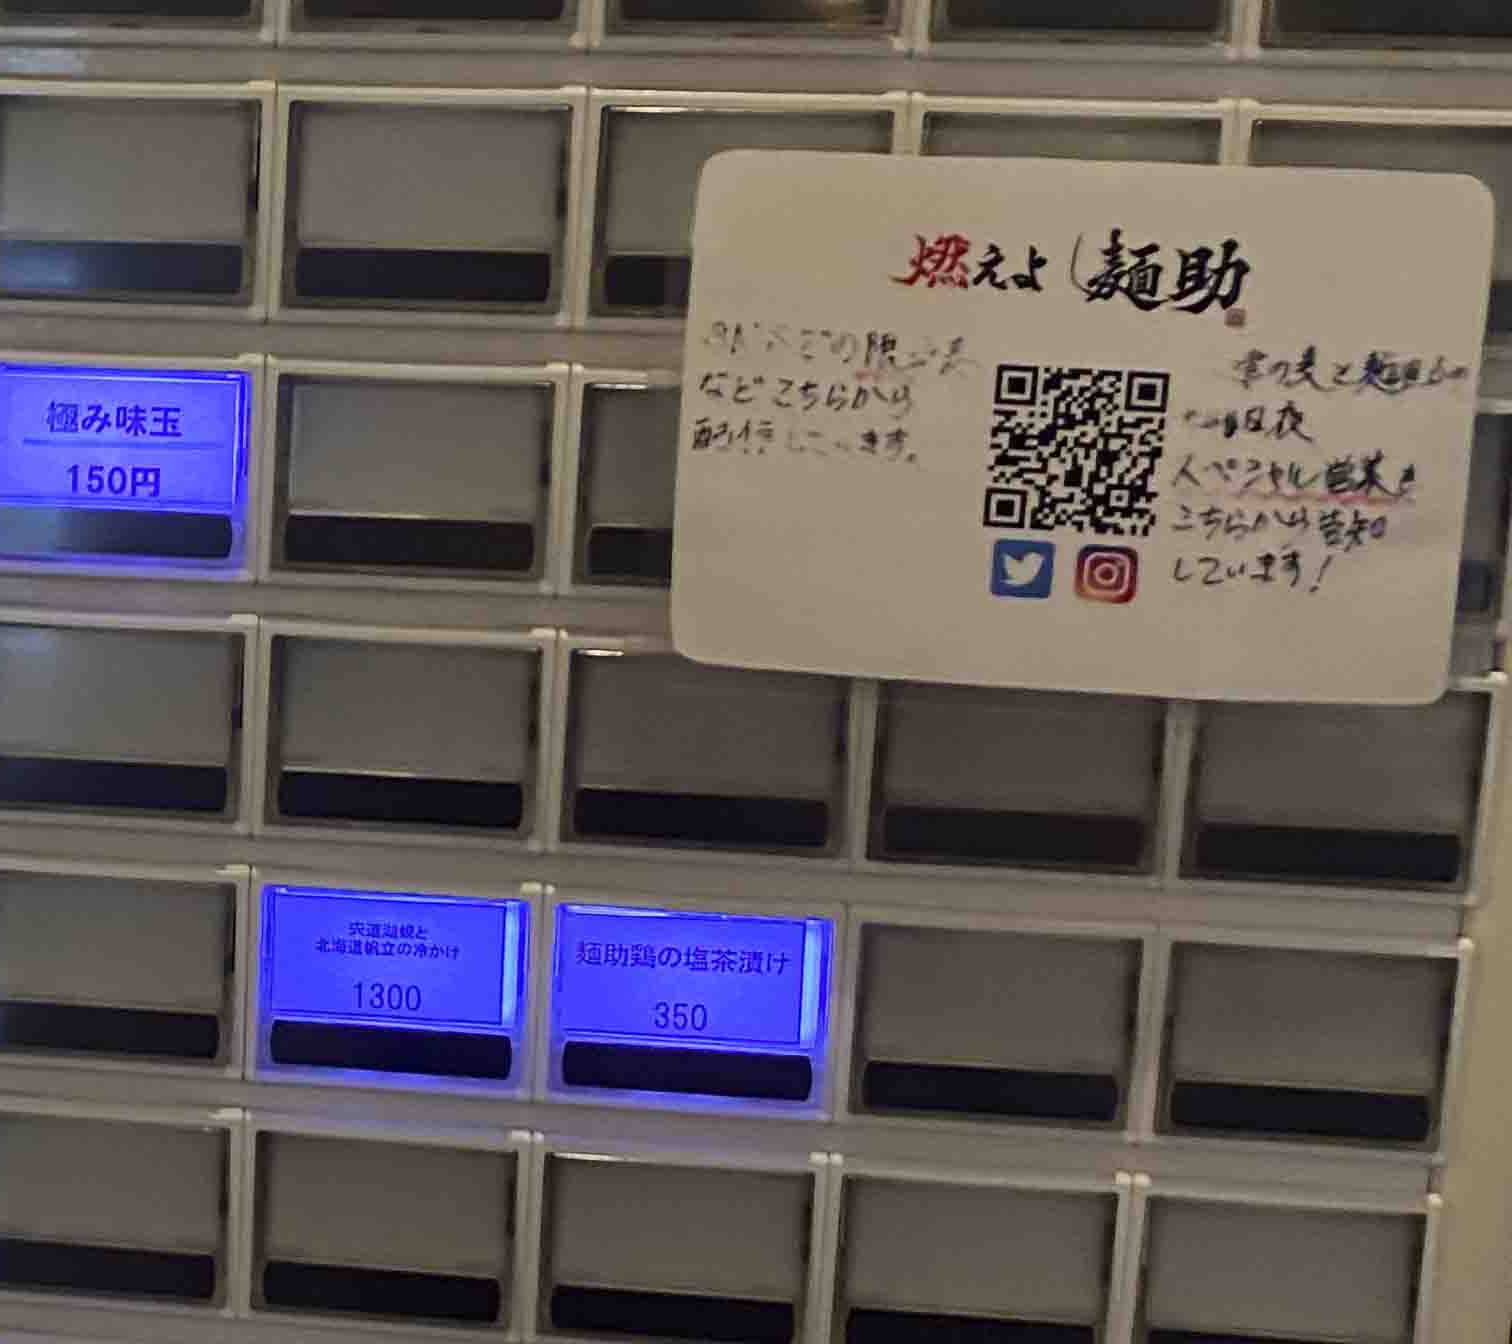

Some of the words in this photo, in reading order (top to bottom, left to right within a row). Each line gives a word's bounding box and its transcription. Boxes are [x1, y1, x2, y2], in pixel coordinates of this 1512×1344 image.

[46, 401, 183, 438] 極み味玉
[66, 464, 162, 498] 150円
[576, 940, 790, 977] 麺助鶏の塩茶漬け
[352, 982, 422, 1012] 1300
[654, 1002, 708, 1033] 350
